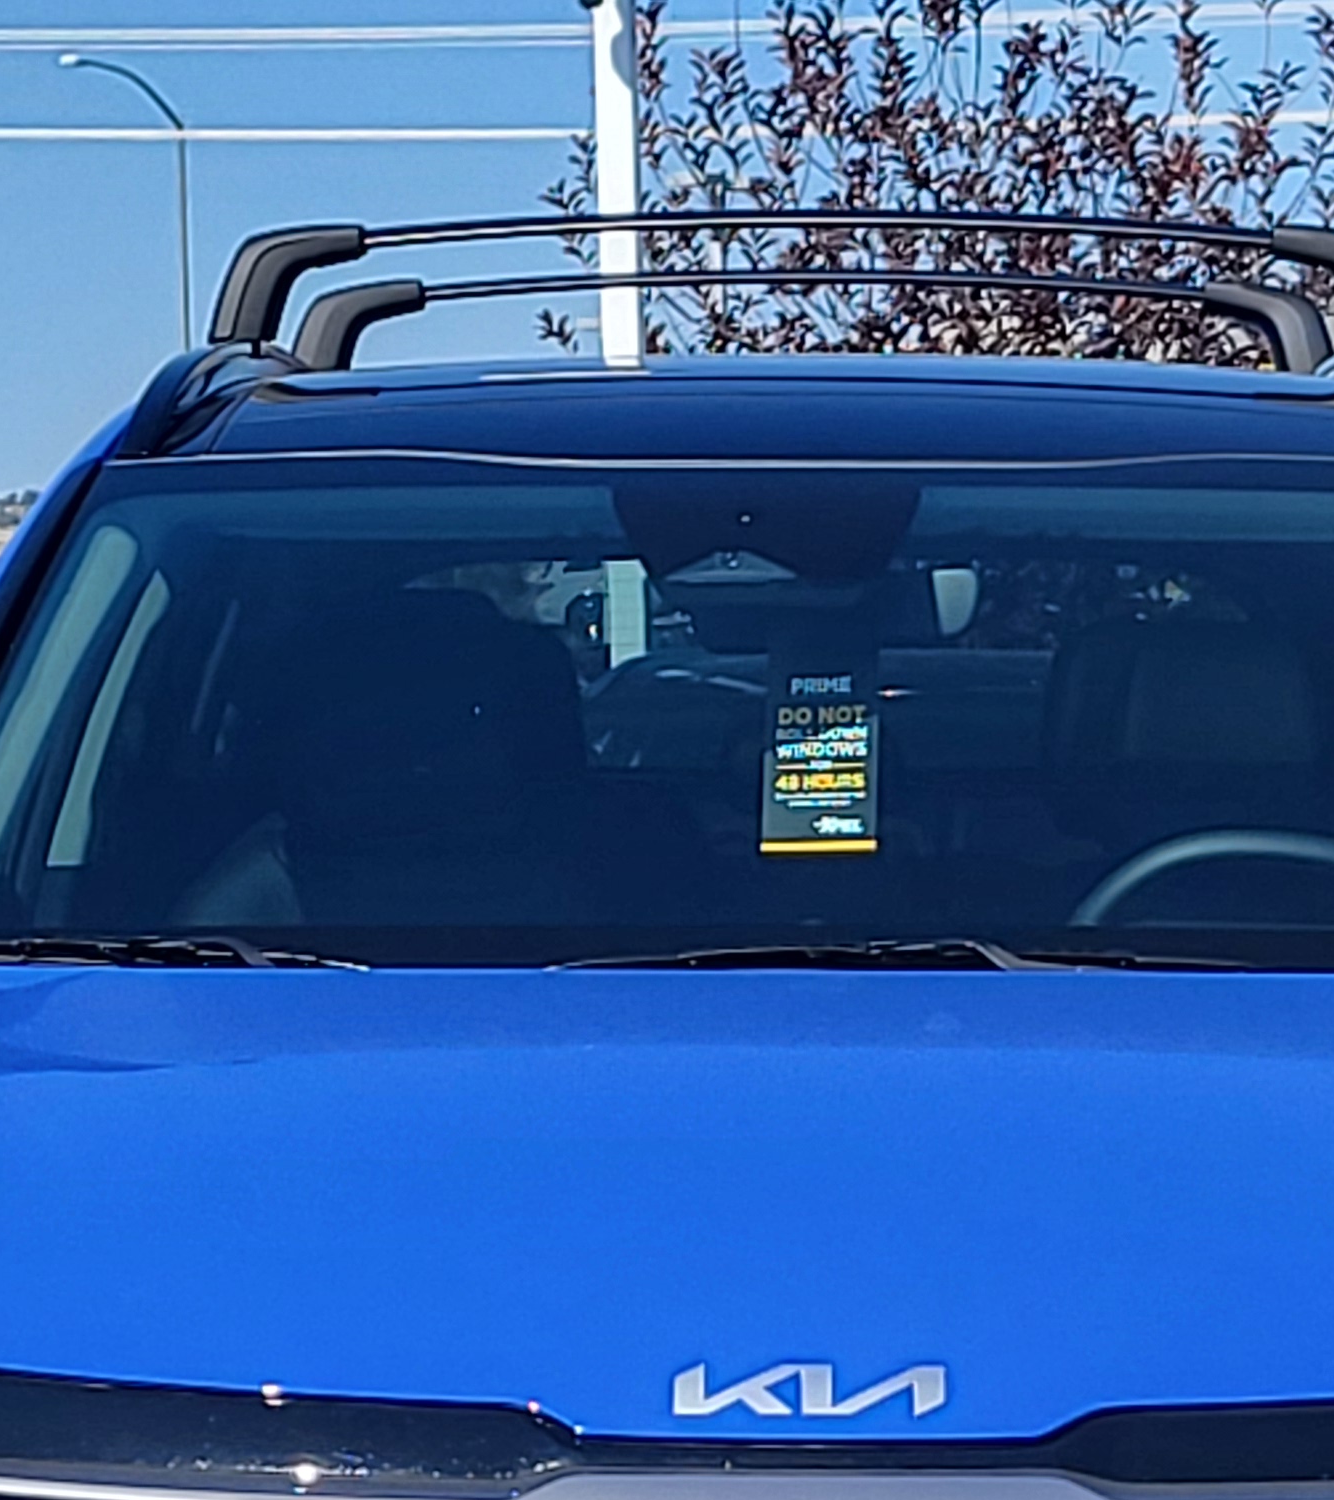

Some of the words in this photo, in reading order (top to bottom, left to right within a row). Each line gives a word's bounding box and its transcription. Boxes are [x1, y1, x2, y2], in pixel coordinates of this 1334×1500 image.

[791, 675, 852, 695] PRIME
[778, 706, 812, 726] DO
[818, 704, 867, 725] NOT
[776, 741, 868, 759] WINDOWS
[673, 1362, 946, 1418] KIA
